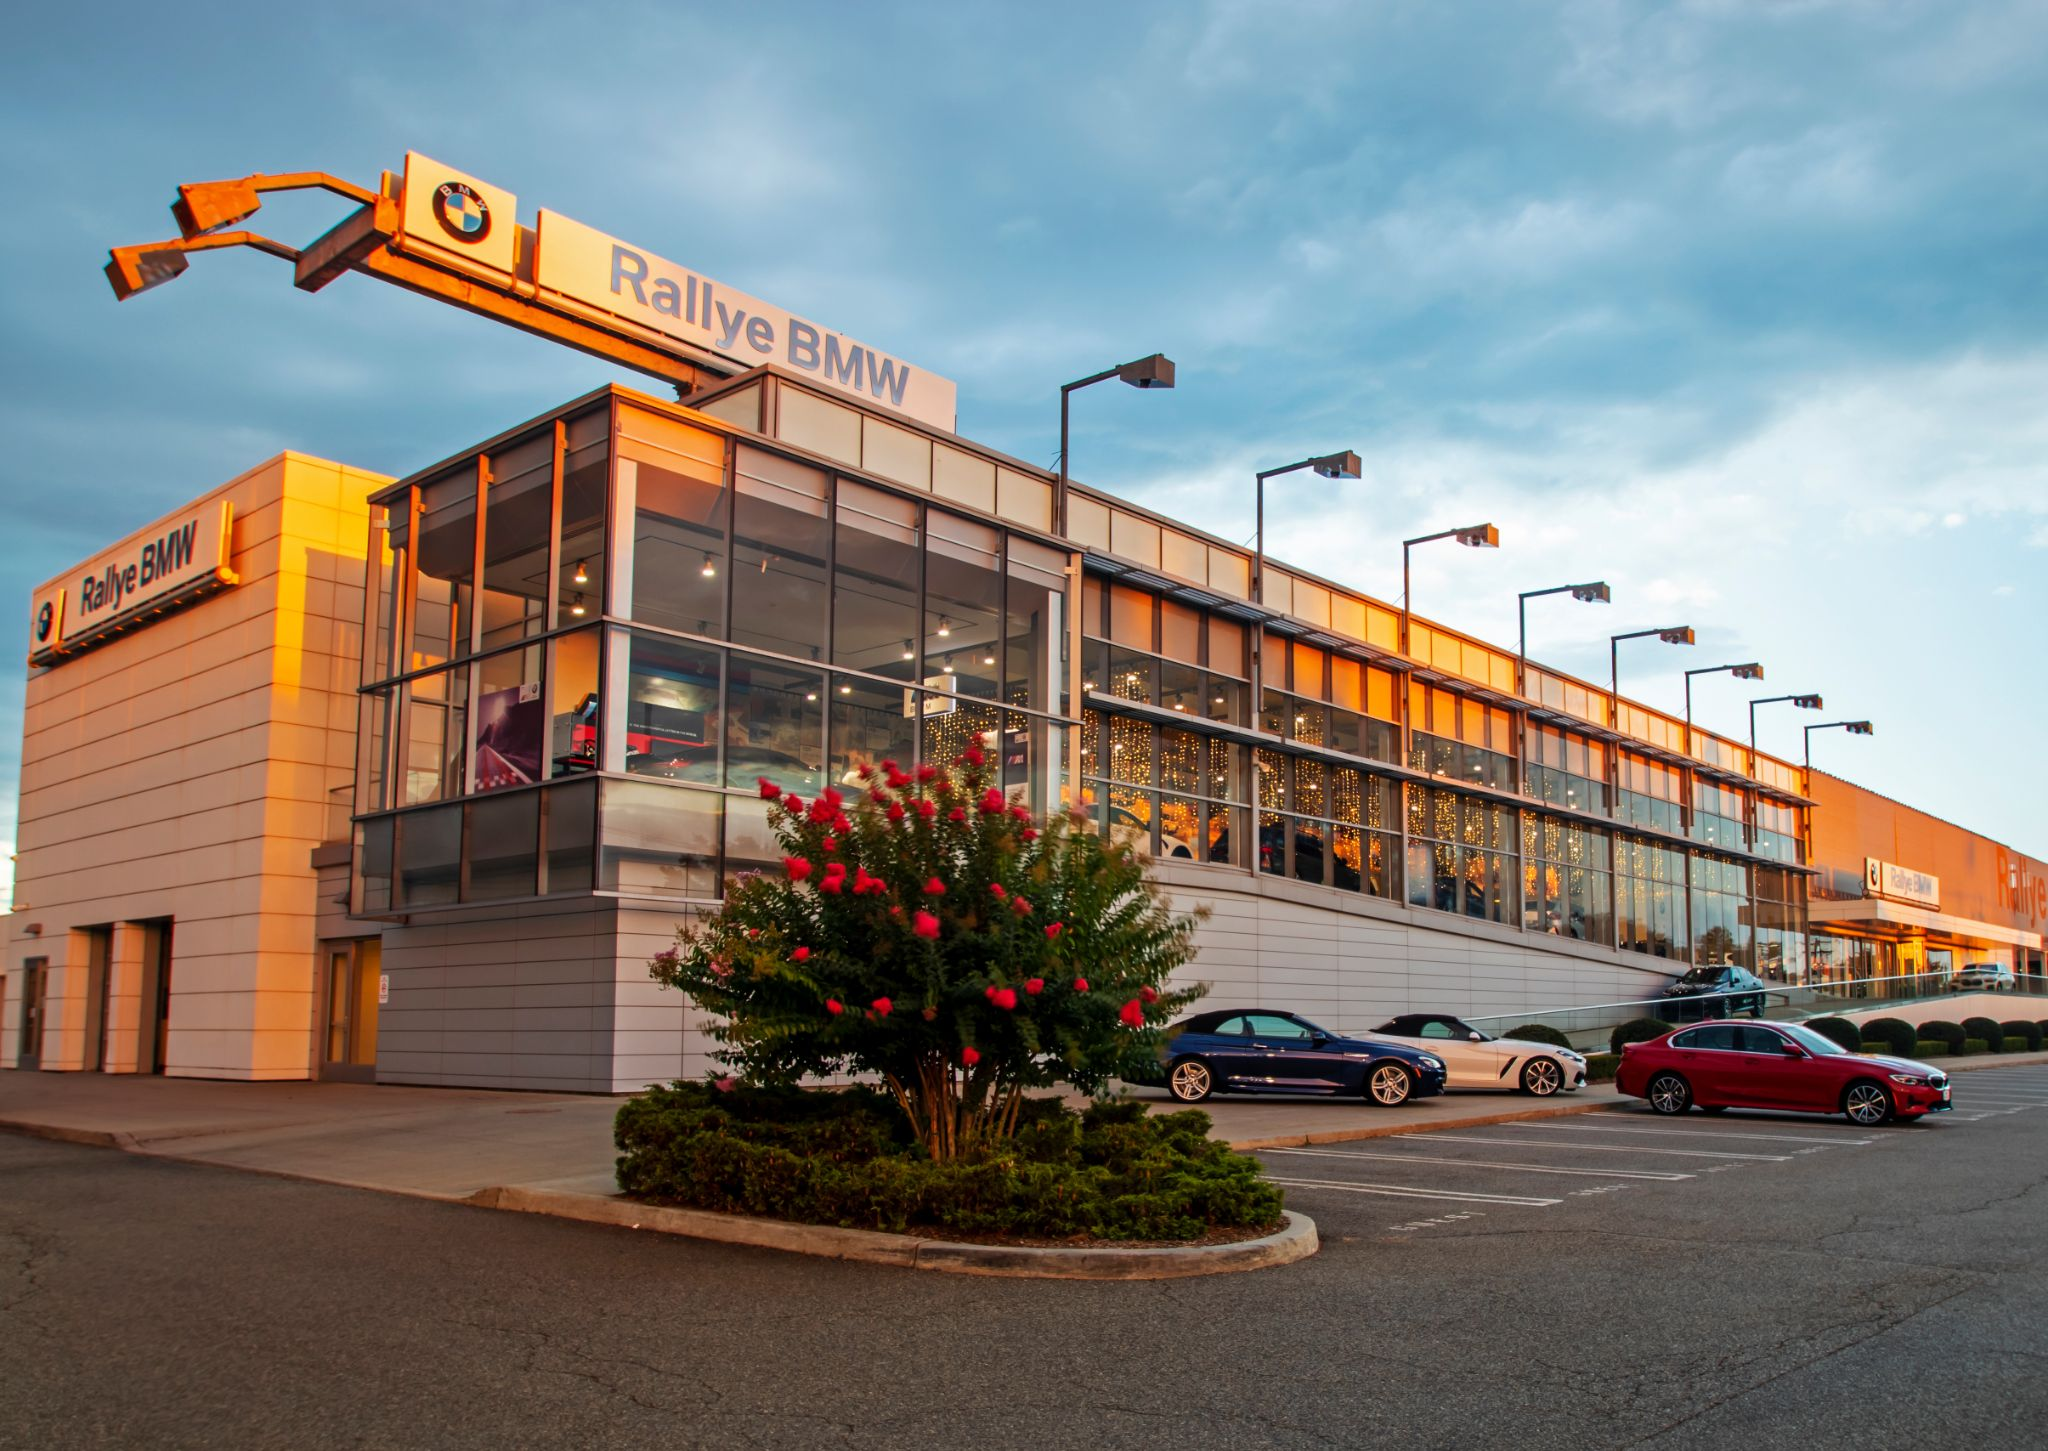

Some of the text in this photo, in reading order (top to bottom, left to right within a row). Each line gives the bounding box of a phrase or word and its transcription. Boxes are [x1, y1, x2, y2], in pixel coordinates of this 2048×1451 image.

[610, 243, 910, 407] Rallye BMW
[81, 519, 198, 617] Rallye BMW
[1890, 866, 1913, 895] Rallye
